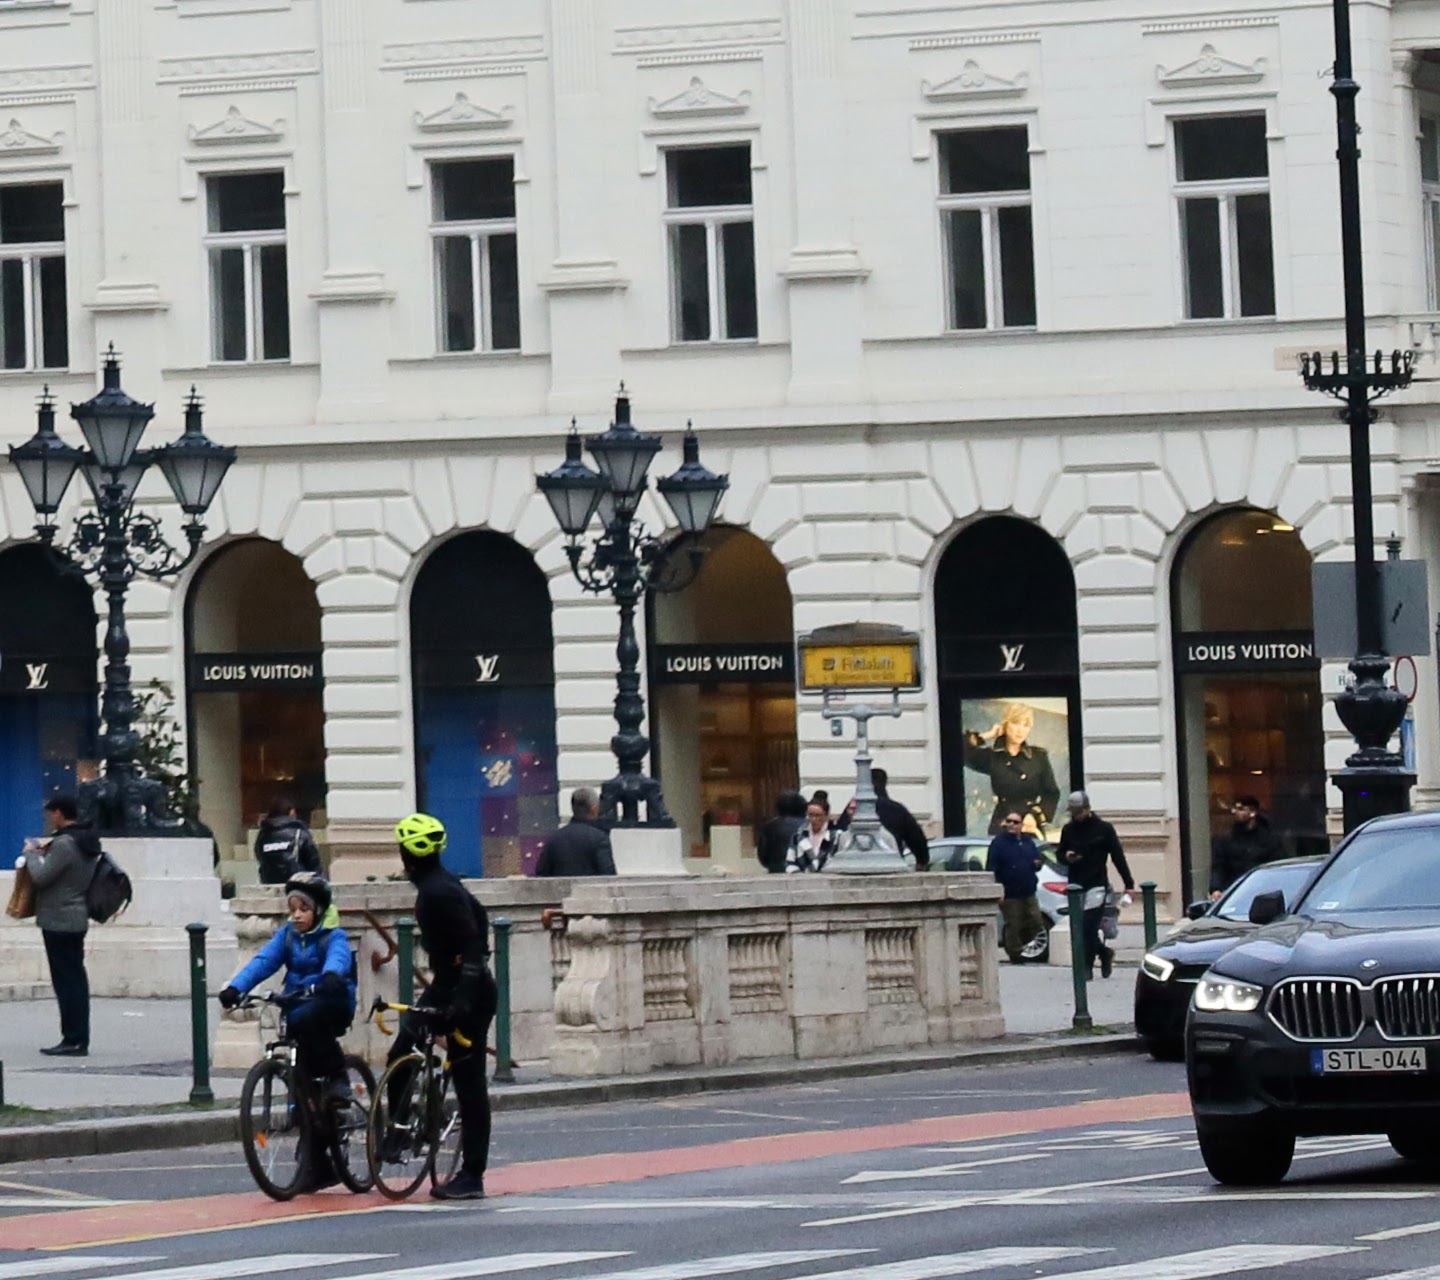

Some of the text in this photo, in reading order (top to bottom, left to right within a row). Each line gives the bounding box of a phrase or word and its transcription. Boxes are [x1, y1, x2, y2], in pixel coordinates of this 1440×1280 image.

[1188, 643, 1313, 661] LOUIS VUITTON
[204, 664, 314, 680] LOUIS VUITTON
[666, 655, 783, 672] LOUIS VUITTON
[1328, 1050, 1421, 1070] STL-044
